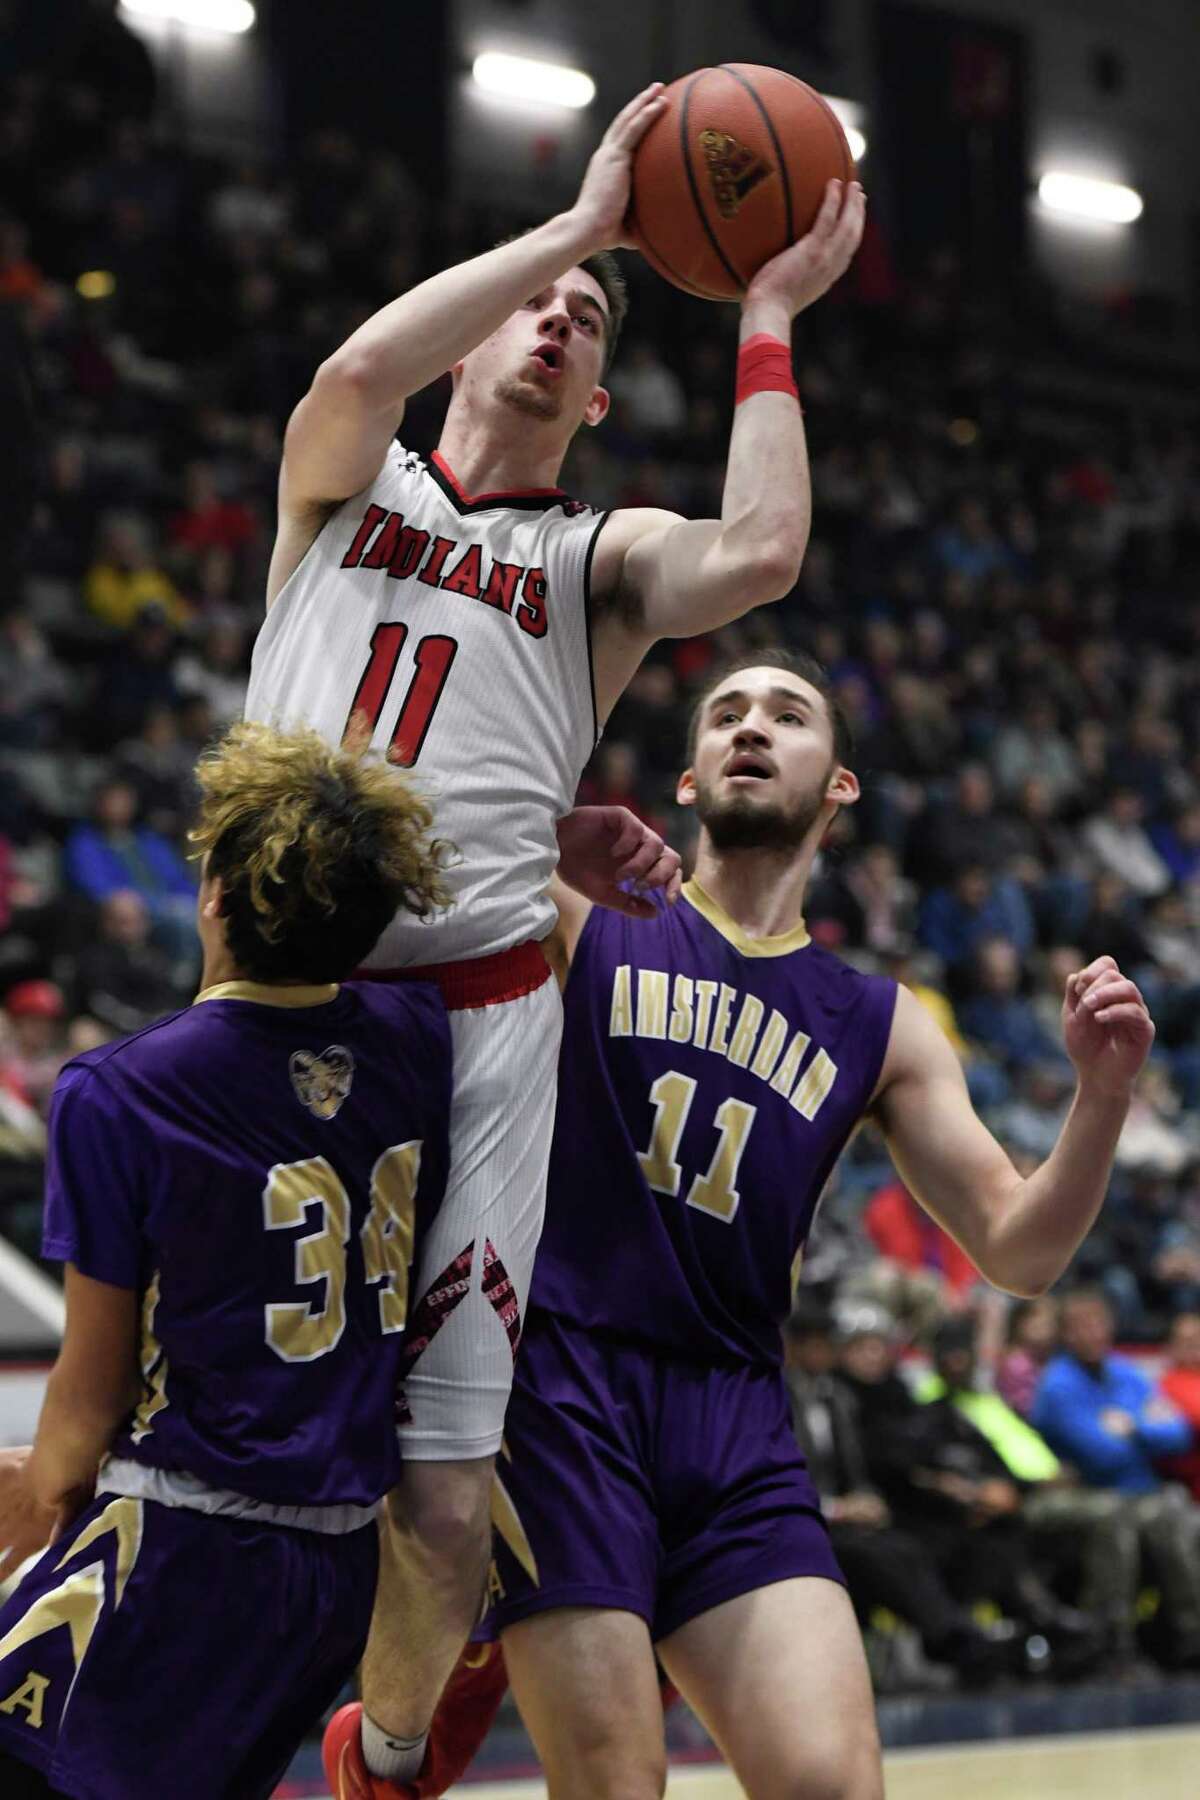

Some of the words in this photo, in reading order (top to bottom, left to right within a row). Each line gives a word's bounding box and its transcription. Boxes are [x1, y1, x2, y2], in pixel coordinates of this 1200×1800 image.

[340, 502, 548, 639] INDIANS
[341, 621, 458, 769] 11
[608, 964, 839, 1122] AMSTERDAM
[635, 1069, 757, 1225] 11
[262, 1139, 424, 1363] 34
[0, 1670, 50, 1729] A
